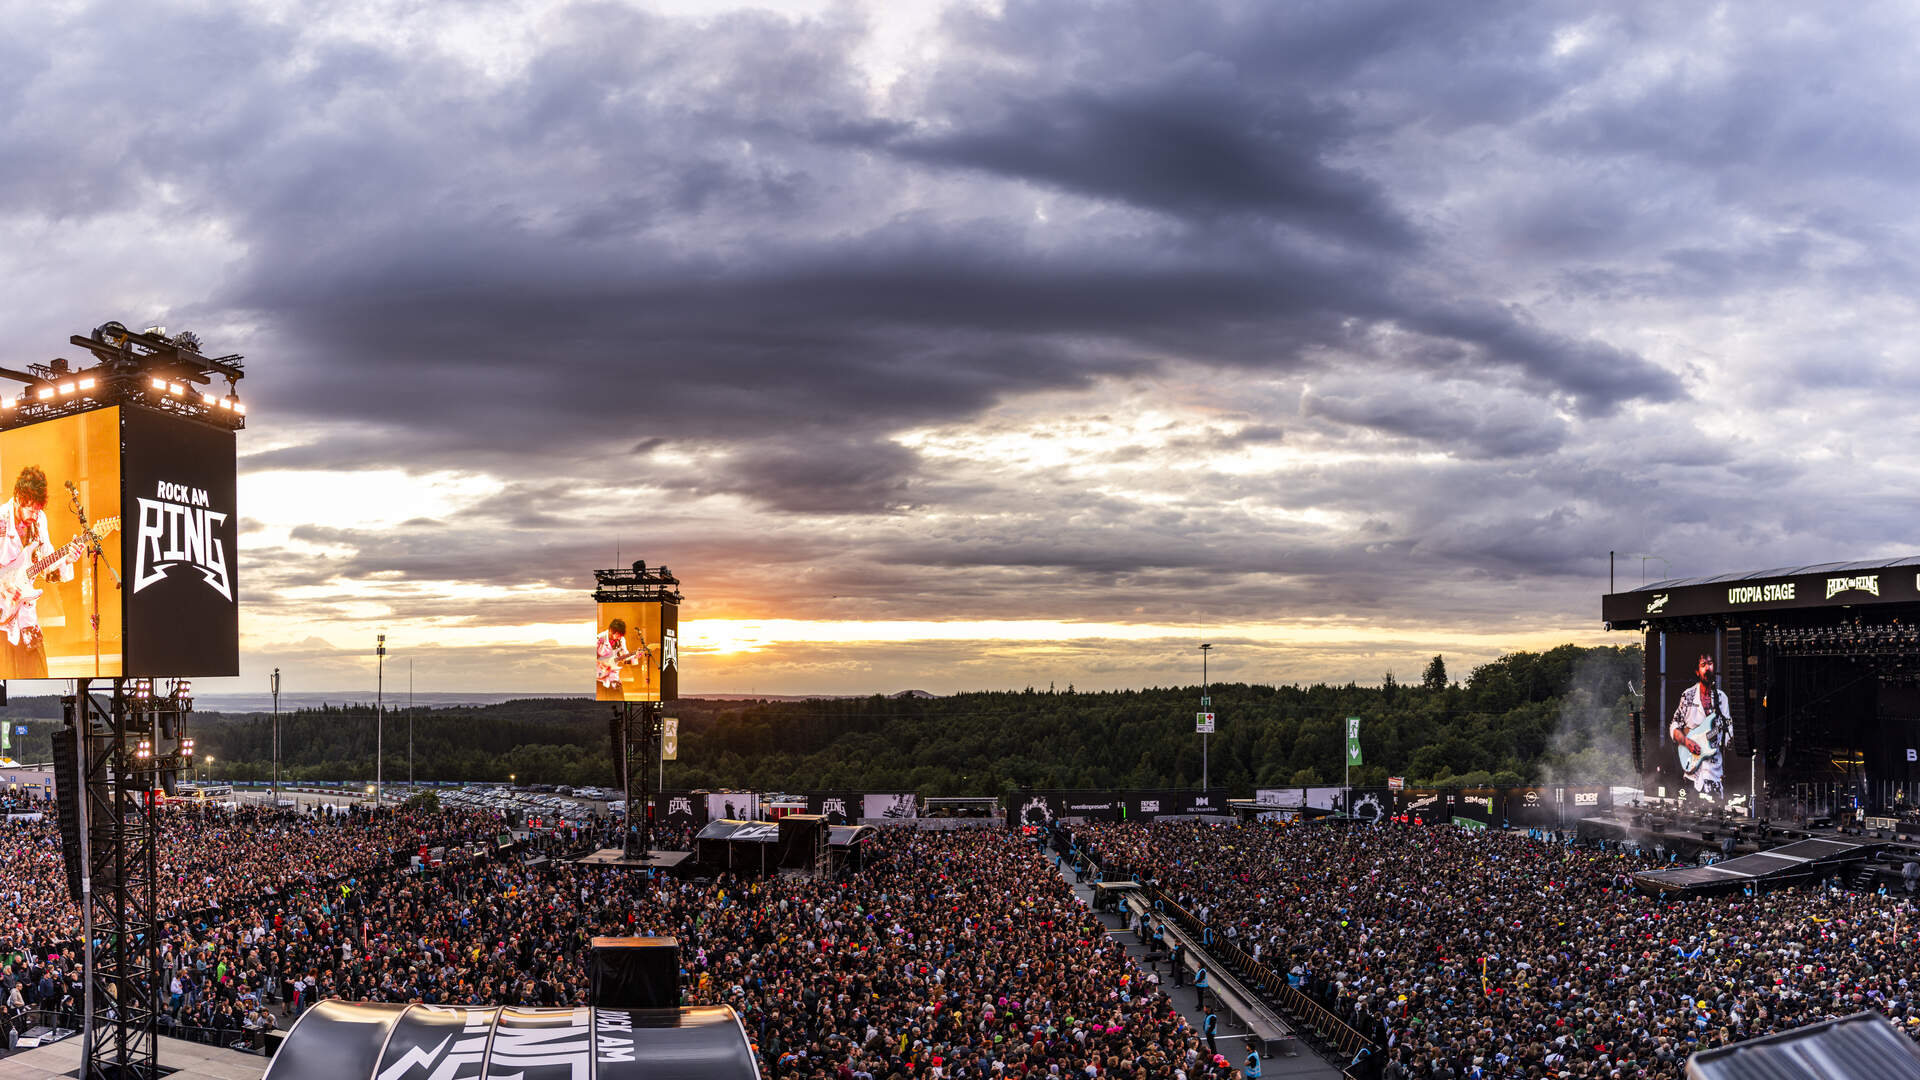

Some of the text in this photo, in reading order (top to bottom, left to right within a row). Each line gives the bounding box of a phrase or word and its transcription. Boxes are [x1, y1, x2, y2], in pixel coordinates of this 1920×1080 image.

[156, 480, 209, 507] ROCK AM
[133, 497, 232, 602] RING
[1728, 583, 1796, 604] UTOPIA STAGE
[1826, 577, 1848, 599] ROCK
[1855, 575, 1879, 597] RING
[668, 799, 693, 816] RING
[822, 801, 847, 817] RING
[595, 1008, 636, 1062] ROCK AM
